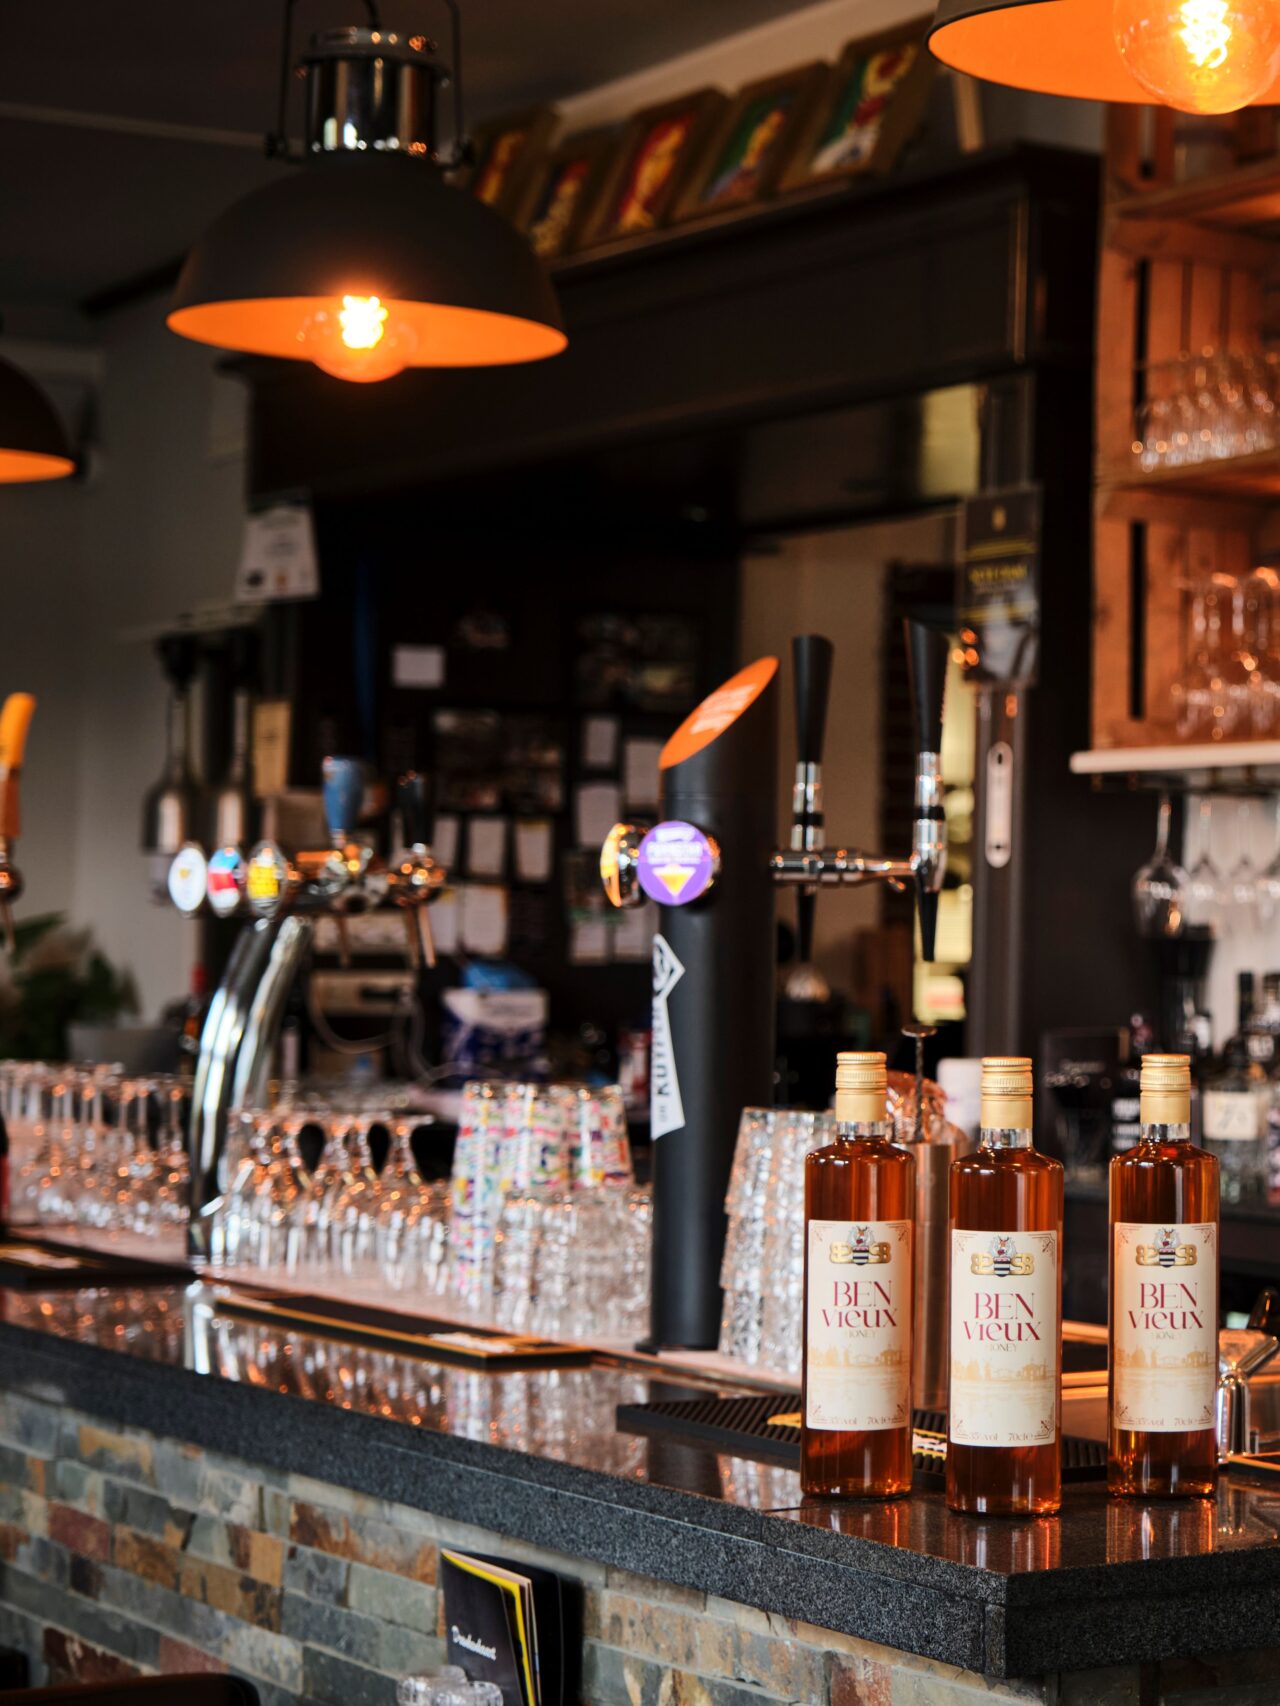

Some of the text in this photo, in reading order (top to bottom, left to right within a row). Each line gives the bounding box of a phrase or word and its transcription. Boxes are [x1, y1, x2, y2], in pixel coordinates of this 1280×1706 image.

[833, 1280, 892, 1307] BEN
[975, 1292, 1035, 1319] BEN
[1140, 1282, 1198, 1309] BEN
